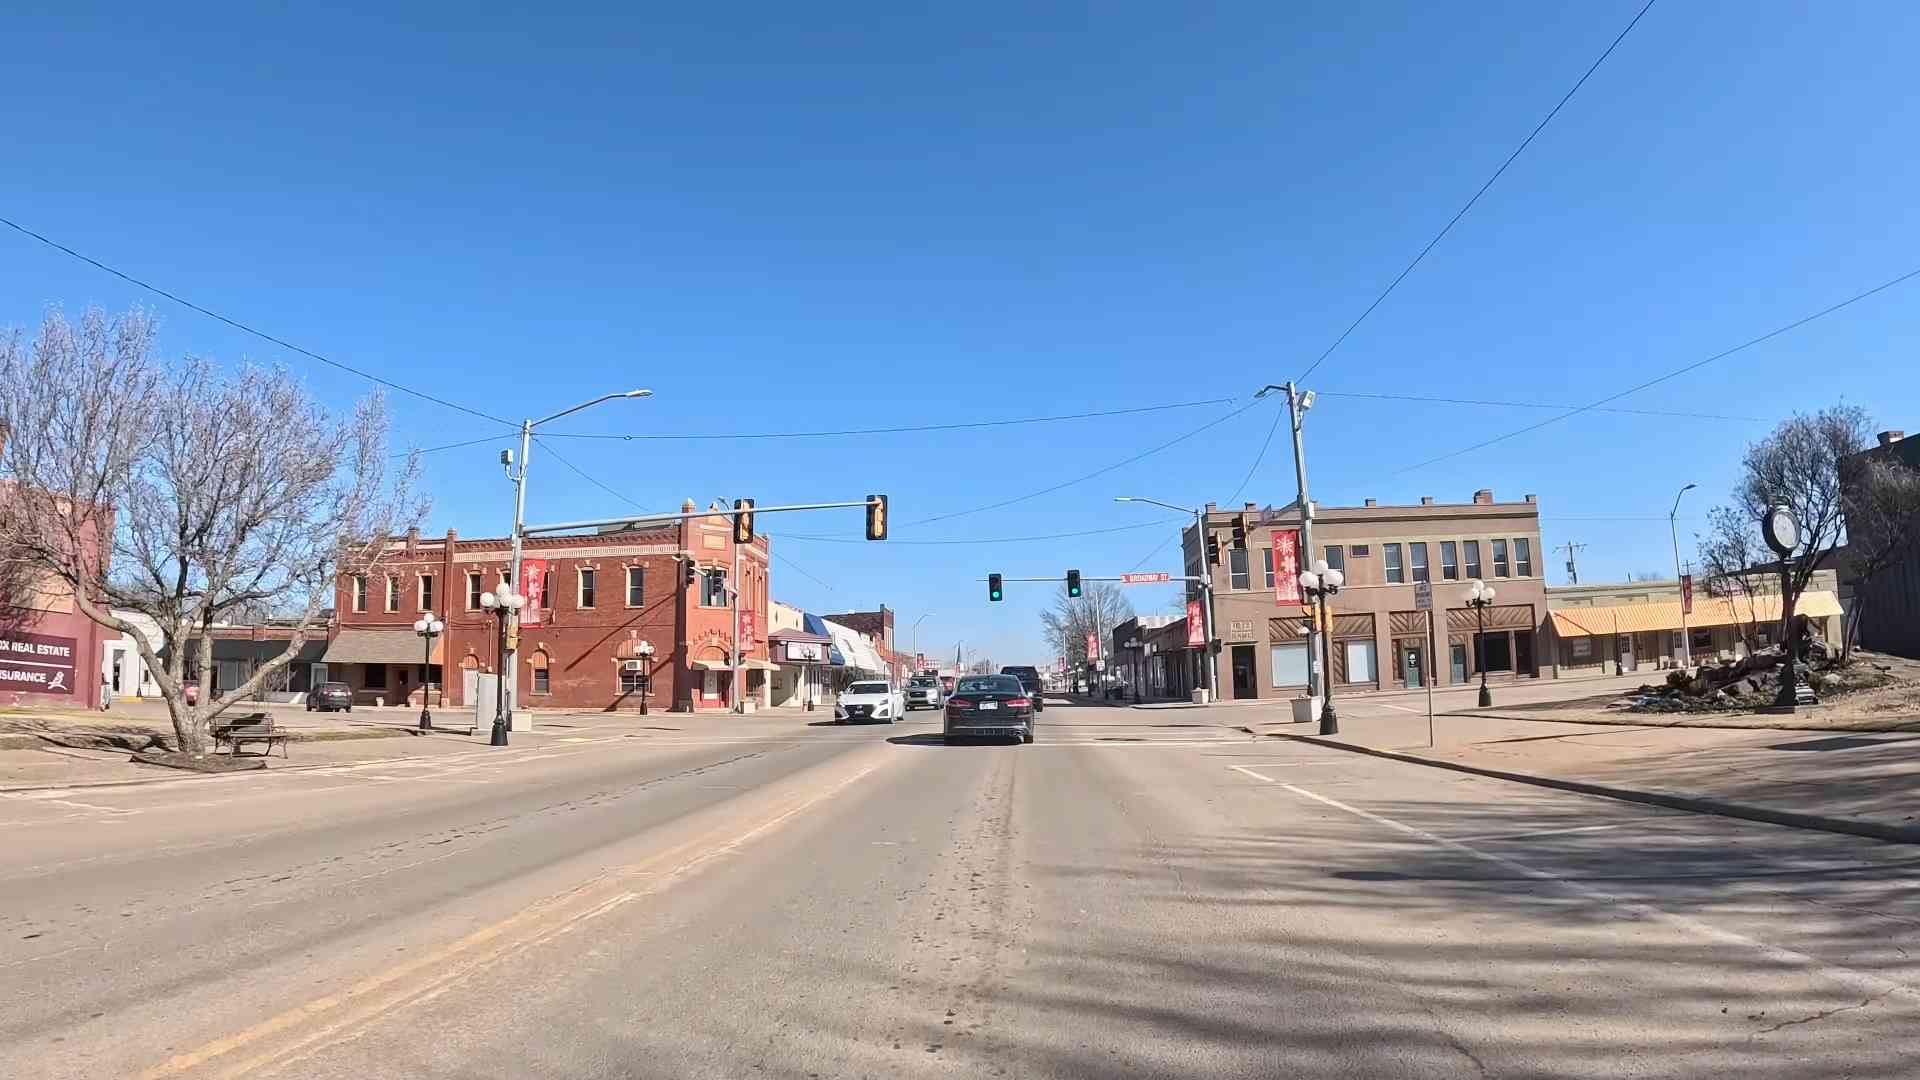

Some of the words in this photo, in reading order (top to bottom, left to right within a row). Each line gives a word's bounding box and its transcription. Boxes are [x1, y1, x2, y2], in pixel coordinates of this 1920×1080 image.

[11, 642, 35, 653] REAL
[37, 645, 70, 656] ESTATE
[0, 670, 46, 682] SURANCE
